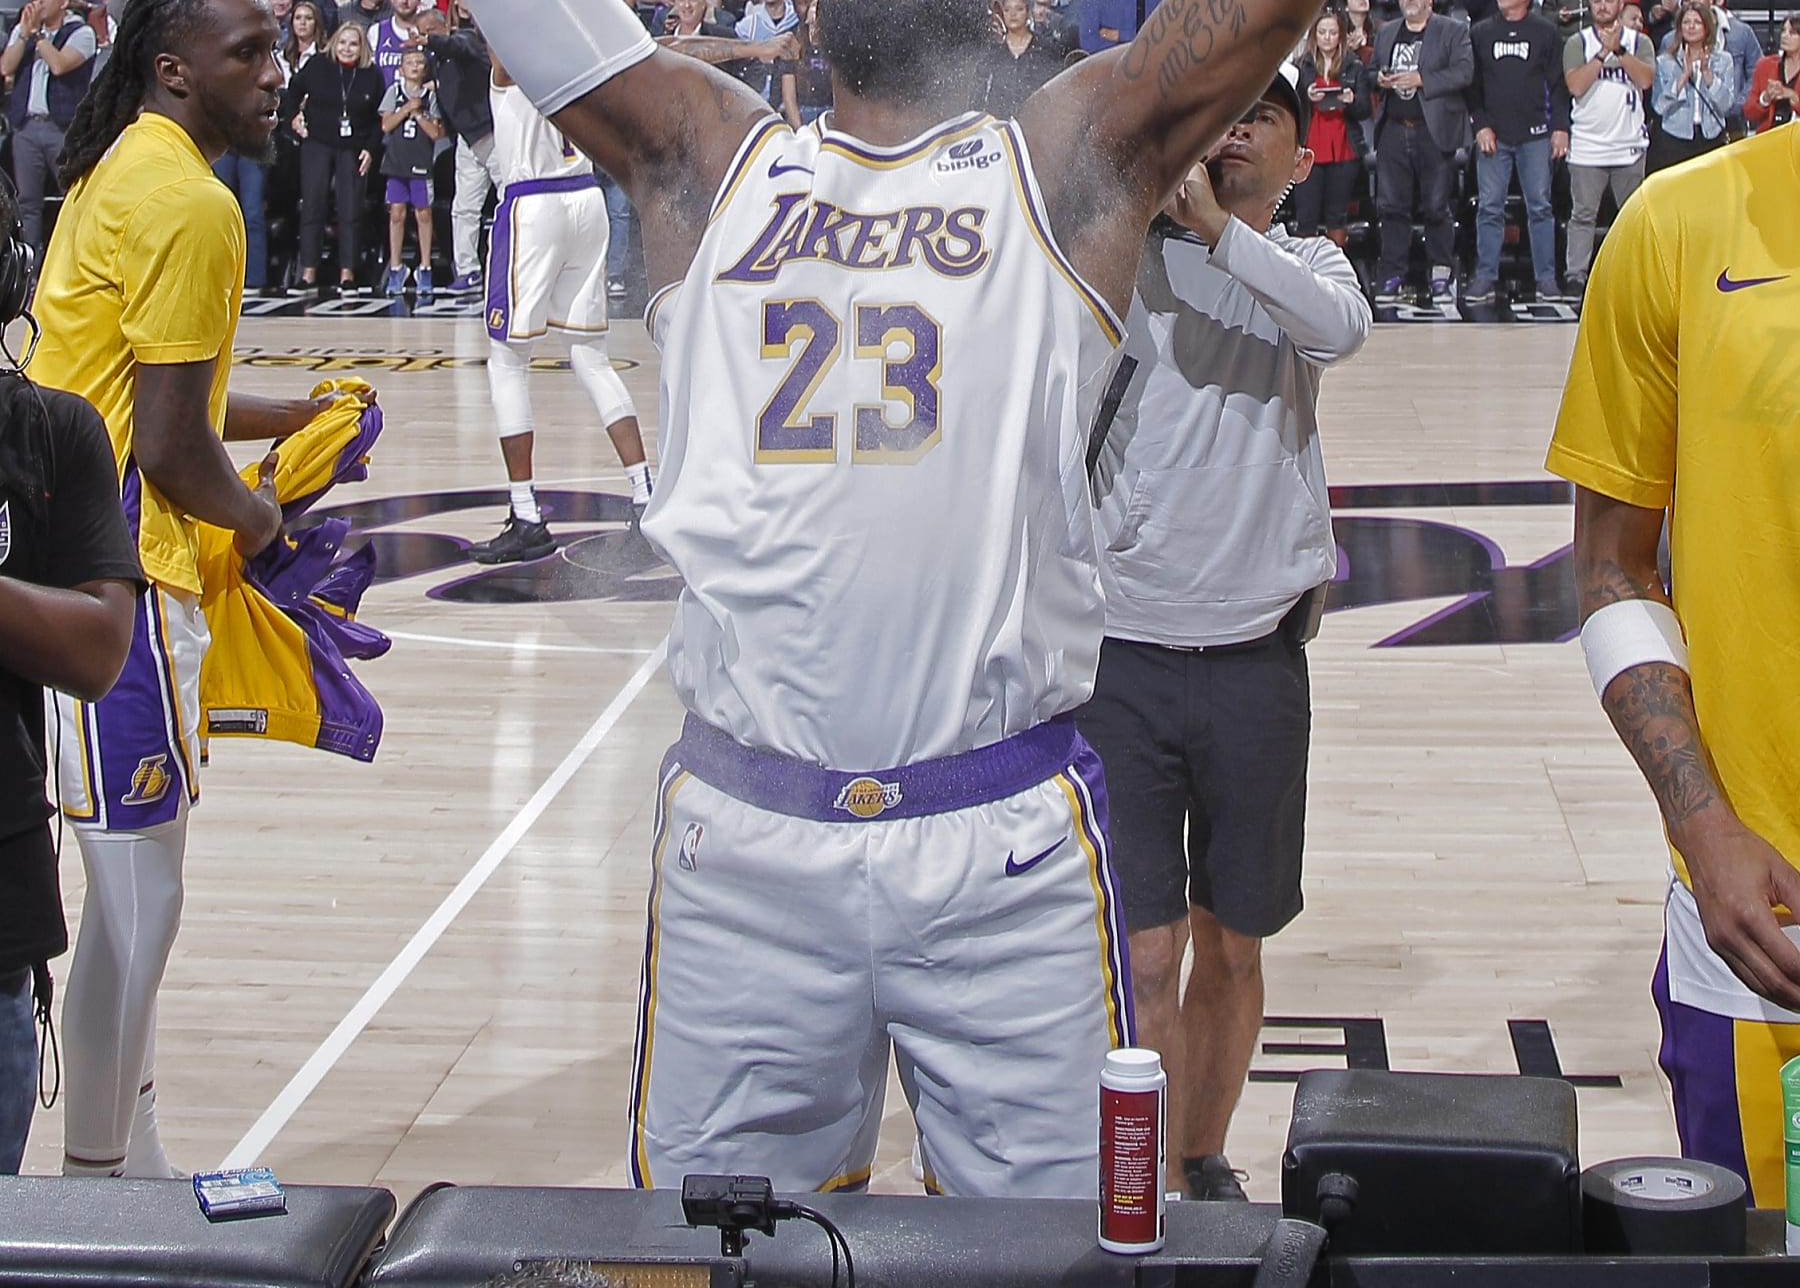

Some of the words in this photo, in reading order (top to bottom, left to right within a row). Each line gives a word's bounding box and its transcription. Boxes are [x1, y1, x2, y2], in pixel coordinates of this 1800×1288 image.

[1493, 41, 1530, 61] KINGS
[403, 119, 418, 139] 5
[936, 151, 1002, 172] bibigo
[712, 189, 993, 286] LAKERS
[753, 296, 944, 465] 23
[833, 788, 904, 809] LAKERS
